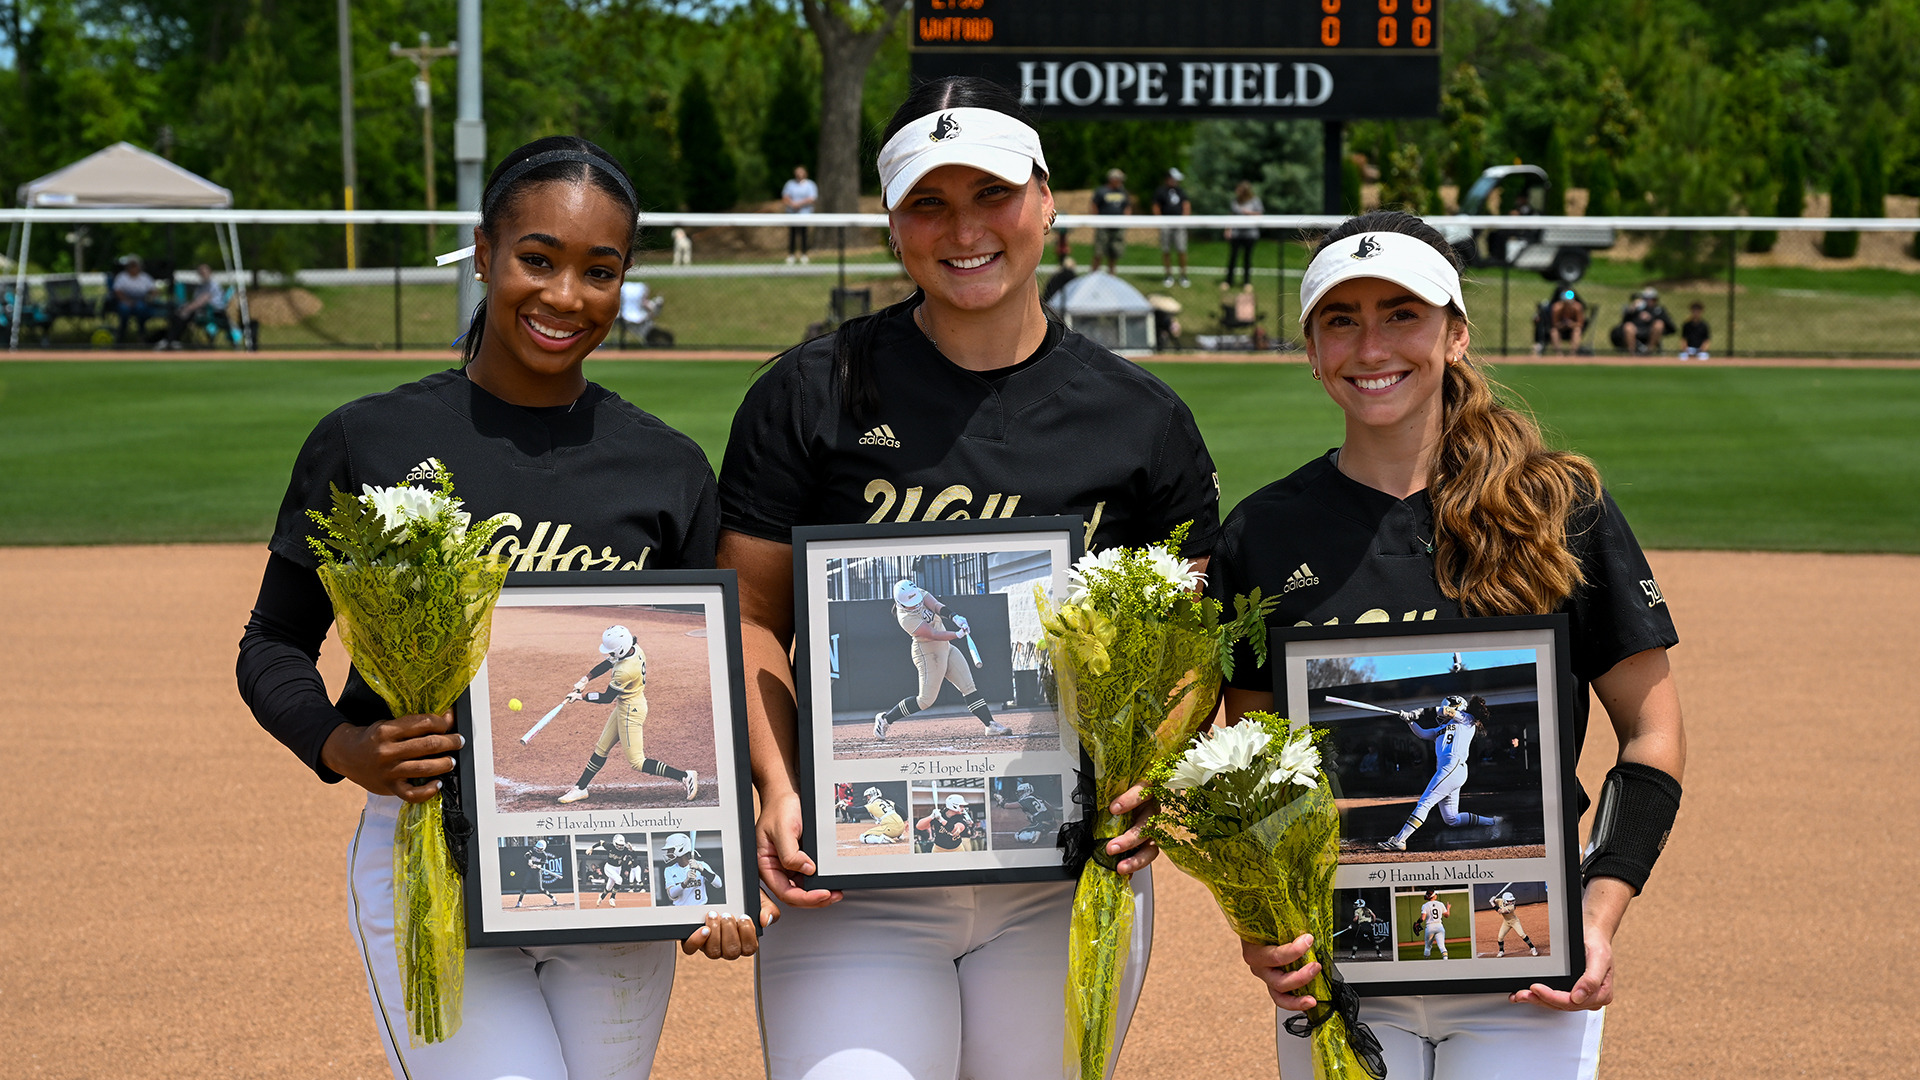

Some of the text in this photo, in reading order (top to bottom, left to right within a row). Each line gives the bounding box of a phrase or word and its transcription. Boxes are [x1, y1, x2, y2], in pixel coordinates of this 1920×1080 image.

[1321, 16, 1341, 47] 0
[1378, 16, 1398, 47] 0
[1411, 16, 1432, 47] 0
[1018, 61, 1334, 107] HOPE FIELD
[858, 434, 901, 448] adidas
[1283, 575, 1320, 594] adidas
[900, 757, 996, 777] #25 Hope Ingle
[536, 811, 683, 832] #8 Havalynn Abernathy
[1368, 863, 1495, 883] #9 Hannah Maddox
